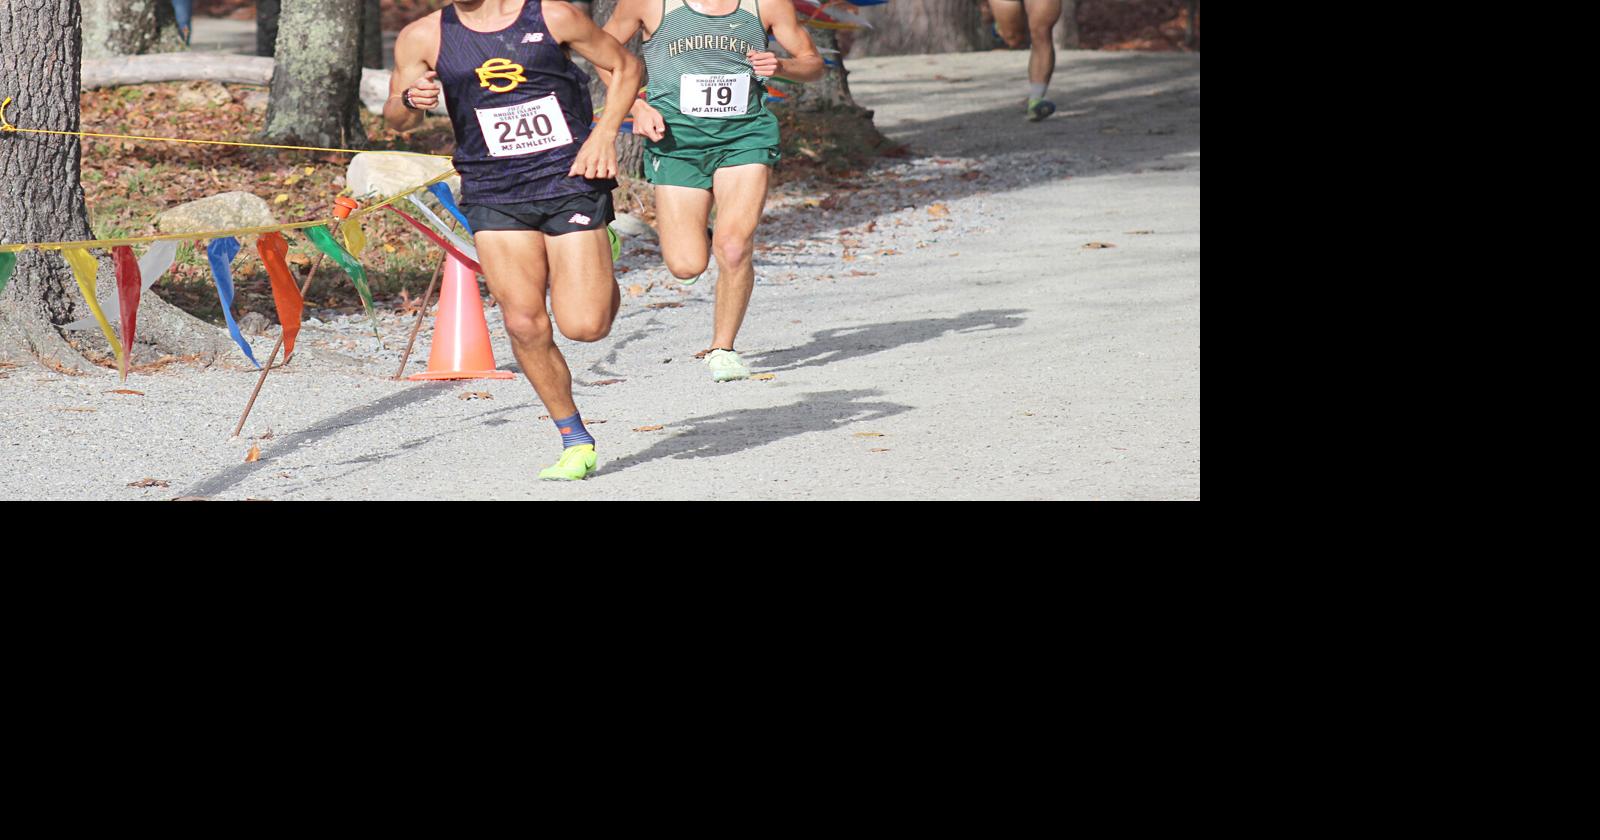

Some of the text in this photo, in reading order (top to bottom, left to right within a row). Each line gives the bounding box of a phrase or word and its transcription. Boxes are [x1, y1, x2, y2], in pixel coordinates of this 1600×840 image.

[701, 86, 732, 106] 19
[703, 105, 737, 113] ATHLETIC
[494, 114, 552, 143] 240
[515, 136, 556, 150] ATHLETIC
